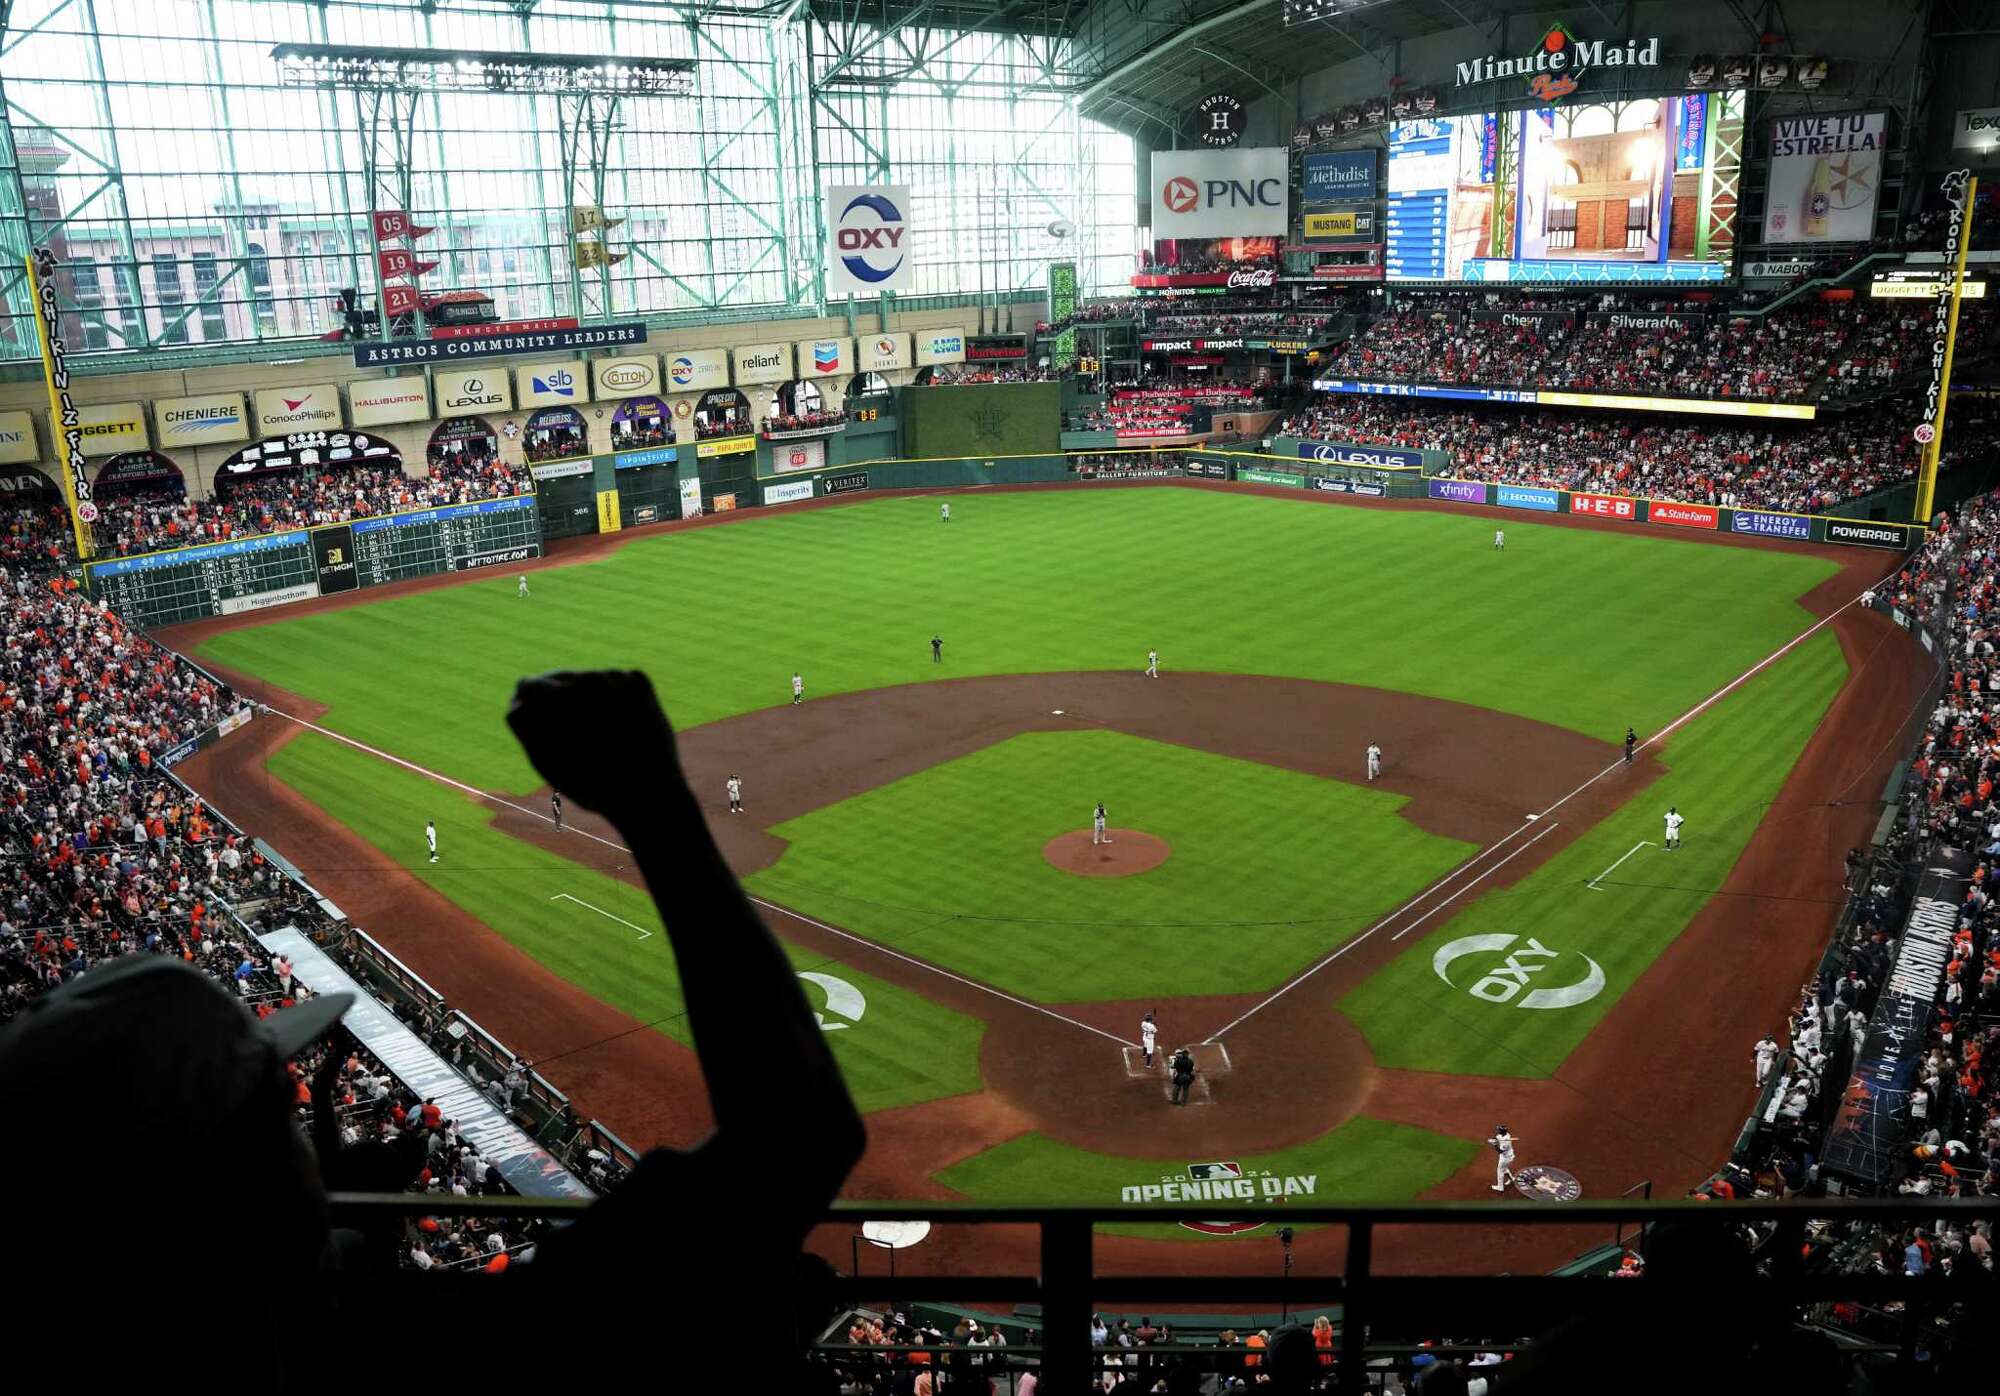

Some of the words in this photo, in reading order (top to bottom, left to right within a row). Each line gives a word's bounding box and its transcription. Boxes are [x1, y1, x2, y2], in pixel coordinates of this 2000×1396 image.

[1456, 49, 1566, 88] Minute
[1573, 38, 1659, 68] Maid
[1200, 95, 1241, 112] HOUSTON
[1211, 112, 1230, 130] H
[1835, 115, 1865, 134] TU
[1202, 130, 1239, 146] ASTROS
[1308, 164, 1370, 185] Methodist
[1203, 178, 1282, 209] PNC
[382, 217, 402, 232] 05
[580, 210, 596, 225] 17
[1312, 219, 1351, 230] MUSTANG
[1356, 218, 1371, 229] CAT
[838, 227, 905, 250] OXY
[387, 255, 406, 271] 19
[1767, 263, 1813, 274] NABOR
[391, 292, 409, 306] 21
[1158, 287, 1196, 296] HORNITOS
[1610, 315, 1679, 329] Silverado
[368, 345, 438, 361] ASTROS
[447, 335, 556, 354] COMMUNITY
[565, 328, 637, 345] LEADERS
[1152, 340, 1191, 352] impact
[1203, 338, 1243, 350] impact
[742, 353, 781, 369] reliant
[548, 370, 573, 387] slb
[671, 367, 694, 376] OXY
[1923, 339, 1945, 421] CHIKIN
[354, 393, 424, 408] HALLIBURTON
[446, 394, 503, 408] LEXUS
[164, 405, 239, 422] CHENIERE
[263, 409, 336, 425] ConocoPhillips
[1338, 451, 1405, 467] LEXUS
[1439, 483, 1475, 499] xfinity
[1510, 493, 1556, 505] HONDA
[574, 507, 589, 516] 366
[1575, 497, 1631, 515] H-E-B
[1753, 514, 1799, 526] ENERGY
[1752, 523, 1808, 537] TRANSFER
[1832, 526, 1901, 543] POWERADE
[467, 549, 528, 568] NITTOTIRE.COM
[320, 562, 354, 575] BETMGM
[1469, 937, 1560, 1003] OXY
[1160, 1174, 1186, 1183] 20
[1121, 1178, 1256, 1203] OPENING
[1261, 1175, 1318, 1197] DAY
